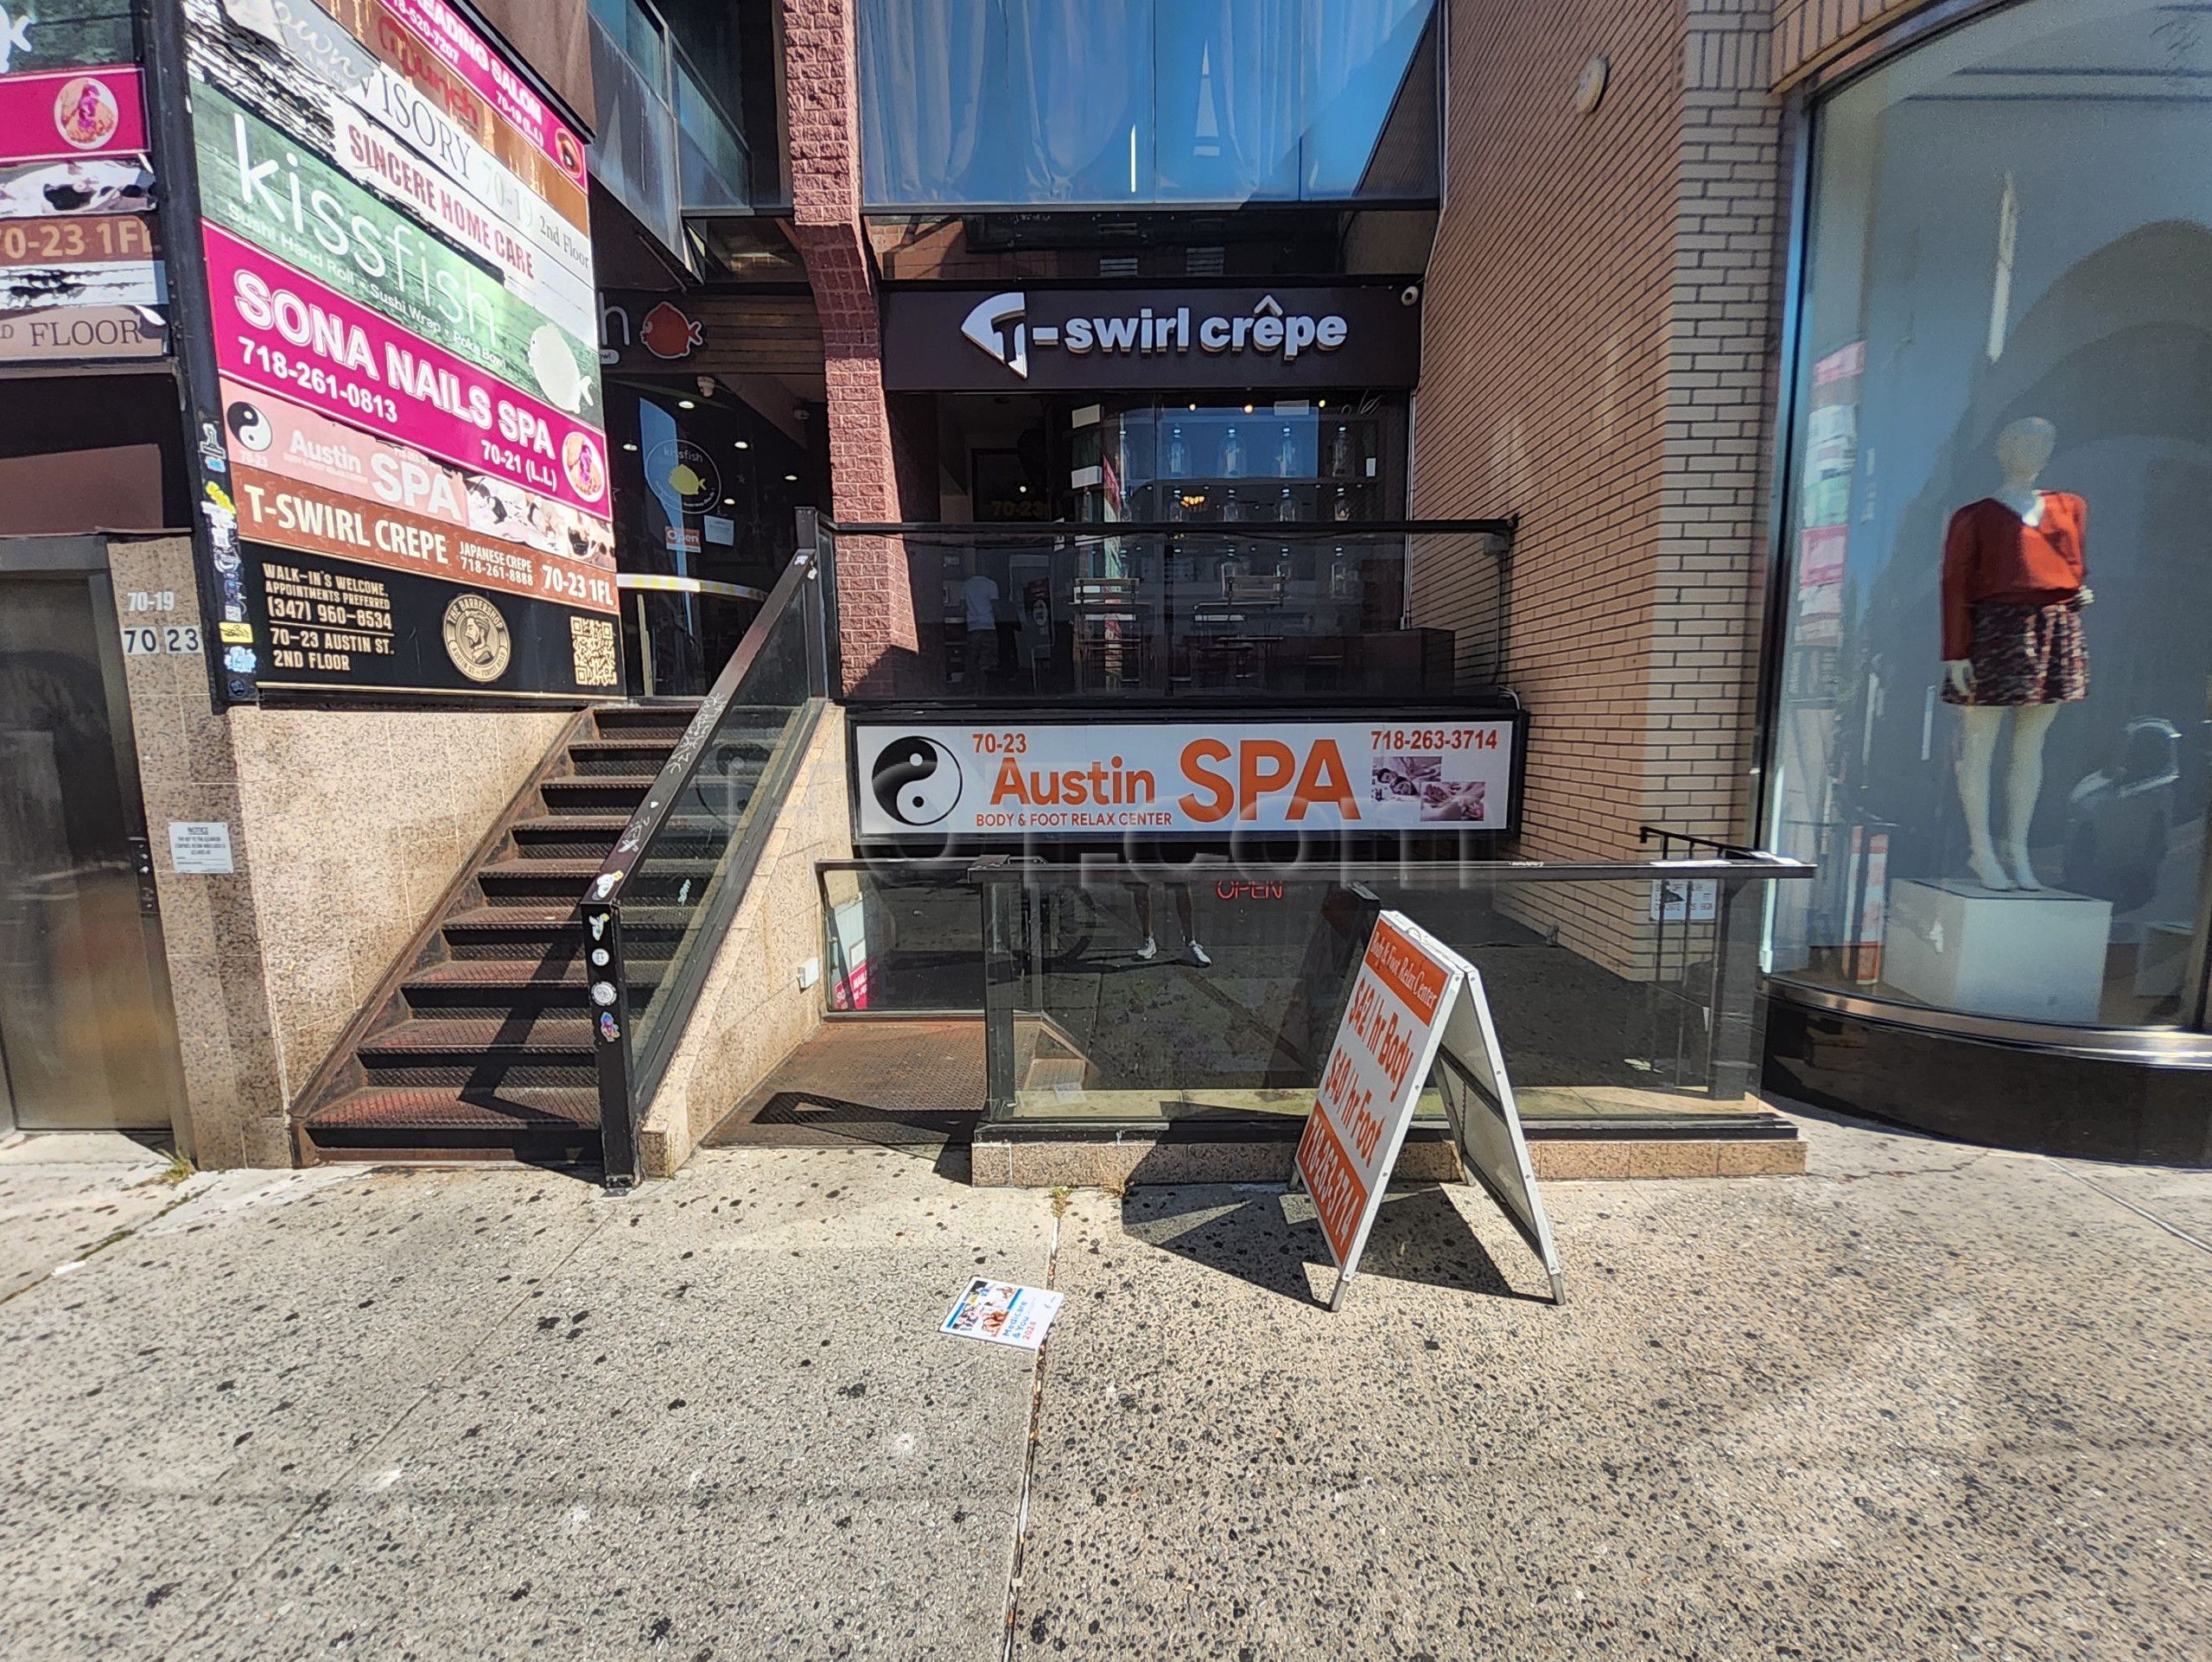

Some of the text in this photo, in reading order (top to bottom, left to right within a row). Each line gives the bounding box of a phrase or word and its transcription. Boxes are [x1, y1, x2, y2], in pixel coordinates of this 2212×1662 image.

[491, 57, 543, 125] SALON
[348, 124, 534, 280] SINCERE HOME CARE
[0, 223, 86, 259] 0-23
[235, 113, 496, 347] kissfish
[540, 215, 560, 245] 2nd
[370, 283, 406, 313] Sushi
[409, 304, 442, 334] Wrap
[29, 319, 142, 347] FLOOR
[1200, 294, 1348, 361] crêpe
[234, 270, 556, 461] SONA NAILS SPA
[238, 335, 398, 423] 718-261-0813
[480, 439, 522, 474] 70-21
[289, 430, 362, 475] Austin
[370, 452, 464, 523] SPA
[244, 484, 449, 564] T-SWIRL CREPE
[459, 541, 532, 574] JAPANESE CREPE
[264, 580, 391, 611] APPOINTMENTS PREFERRED
[460, 556, 615, 607] 718-261-8888 70-23 1FL
[126, 591, 175, 613] 70-19
[267, 595, 393, 631] (347) 960-8534
[447, 597, 504, 629] THE BARBERSHOP
[123, 627, 157, 653] 70
[165, 627, 200, 653] 23
[270, 627, 320, 649] 70-23
[324, 632, 372, 653] AUSTIN
[375, 637, 396, 656] ST.
[272, 649, 352, 672] 2ND FLOOR
[972, 733, 1027, 754] 70-23
[1370, 729, 1498, 751] 718-263-3714
[989, 737, 1363, 824] Austin SPA
[976, 812, 1173, 827] BODY & FOOT RELAX CENTER
[1216, 878, 1285, 901] OPEN
[1413, 970, 1438, 1010] Center
[1377, 1011, 1414, 1104] Body
[1351, 1088, 1387, 1168] Foot
